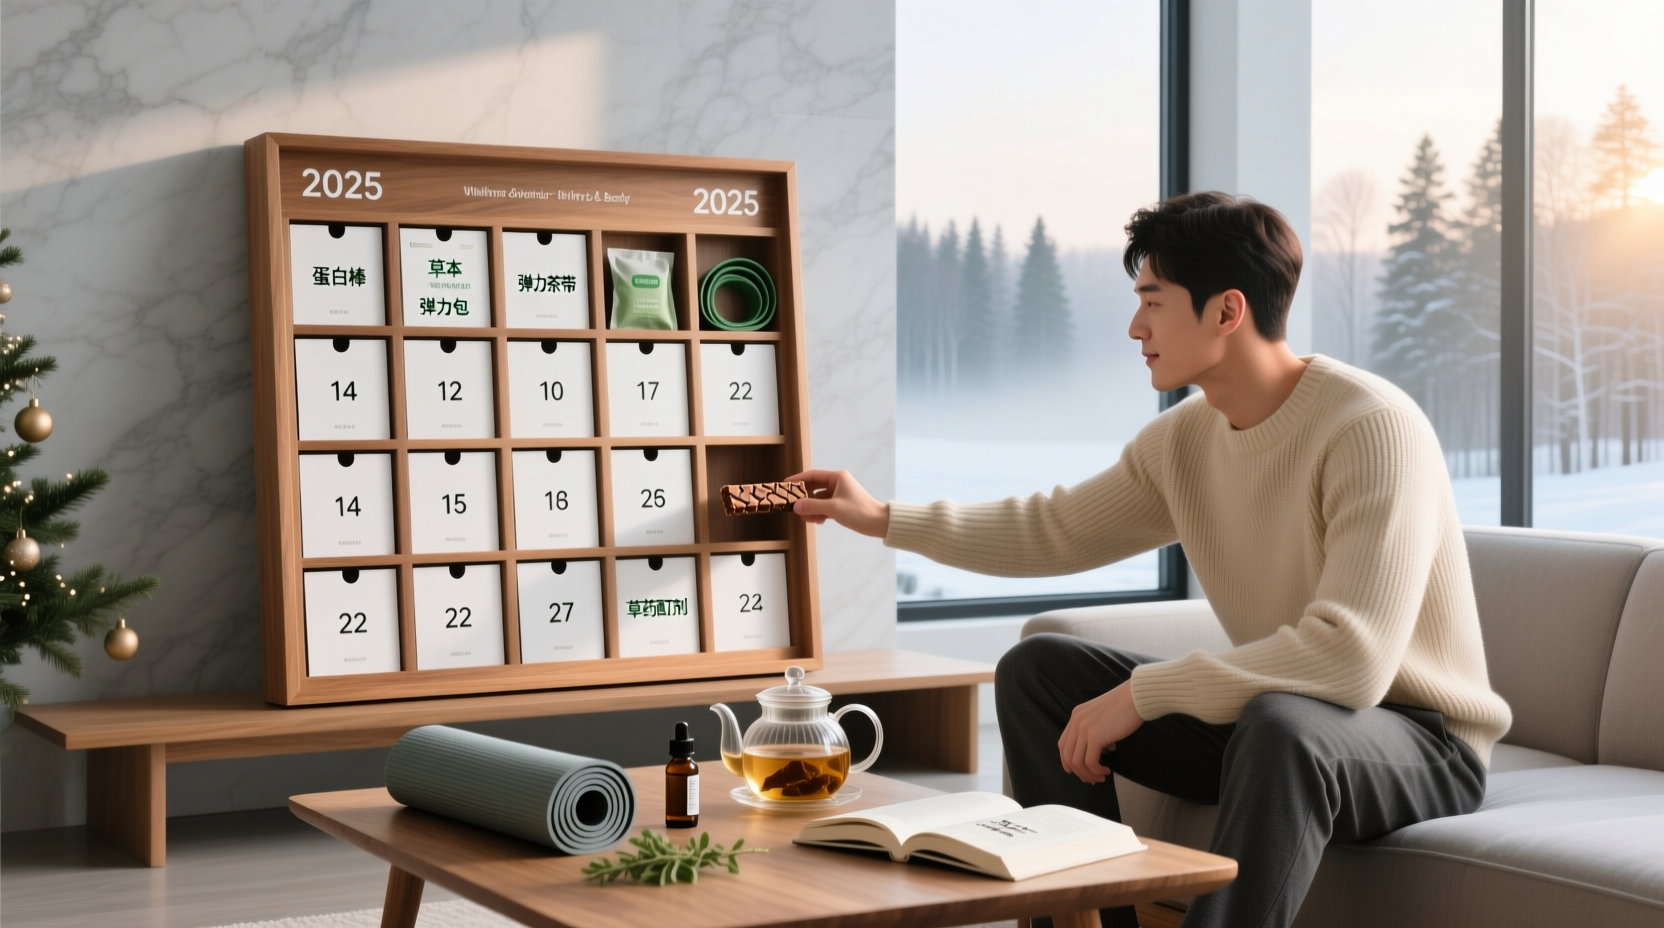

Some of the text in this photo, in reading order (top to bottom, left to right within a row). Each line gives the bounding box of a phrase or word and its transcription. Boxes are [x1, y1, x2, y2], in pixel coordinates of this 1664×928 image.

[302, 168, 382, 201] 2025
[693, 188, 759, 216] 2025
[312, 265, 367, 288] 蛋白棒
[427, 258, 463, 279] 草本
[517, 272, 577, 294] 弹力茶带
[419, 296, 470, 317] 弹力包
[330, 380, 358, 402] 14
[437, 380, 463, 402] 12
[539, 380, 564, 402] 10
[636, 380, 660, 401] 17
[729, 381, 753, 401] 22
[334, 495, 362, 517] 14
[441, 493, 467, 515] 15
[338, 611, 368, 635] 22
[444, 606, 473, 629] 22
[548, 601, 575, 624] 27
